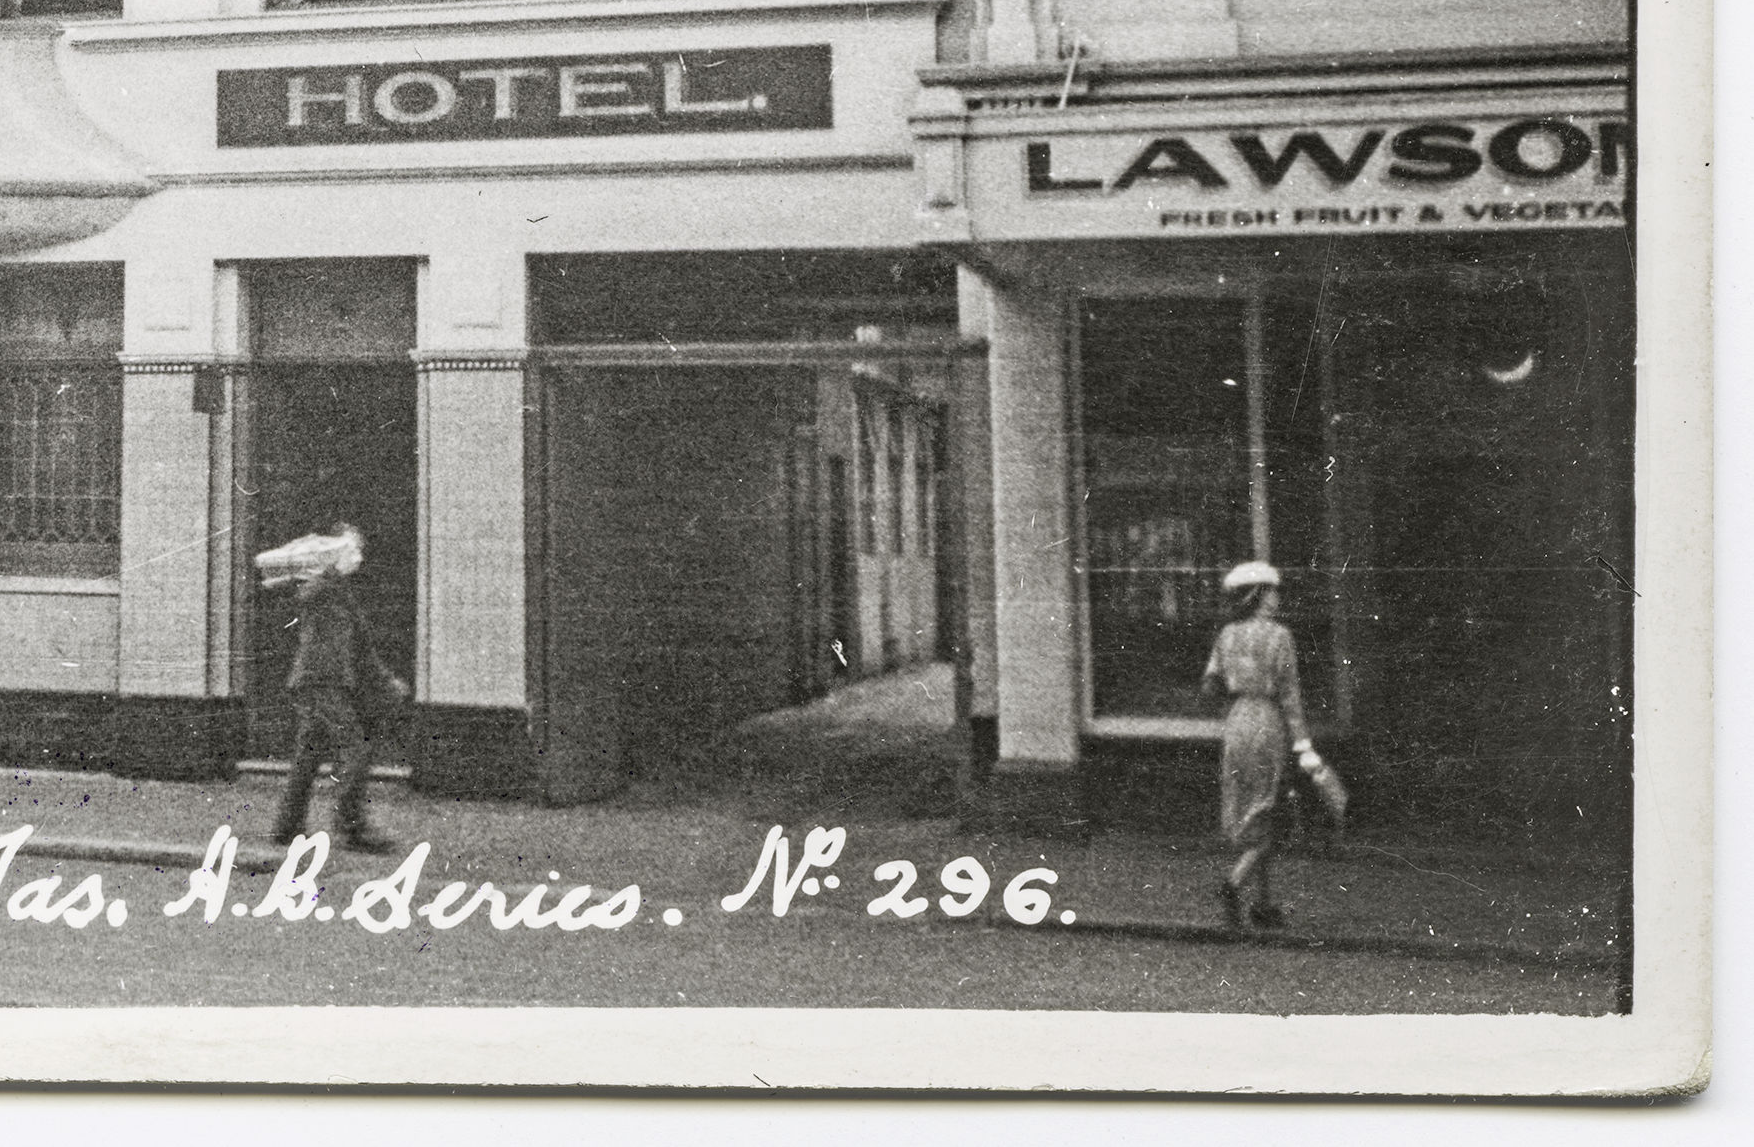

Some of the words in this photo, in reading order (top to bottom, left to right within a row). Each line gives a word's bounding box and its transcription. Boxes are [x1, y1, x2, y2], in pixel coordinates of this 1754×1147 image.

[287, 60, 767, 127] HOTEL.
[1159, 209, 1280, 229] FRESH
[1294, 205, 1405, 225] FRUIT
[1418, 203, 1445, 222] &
